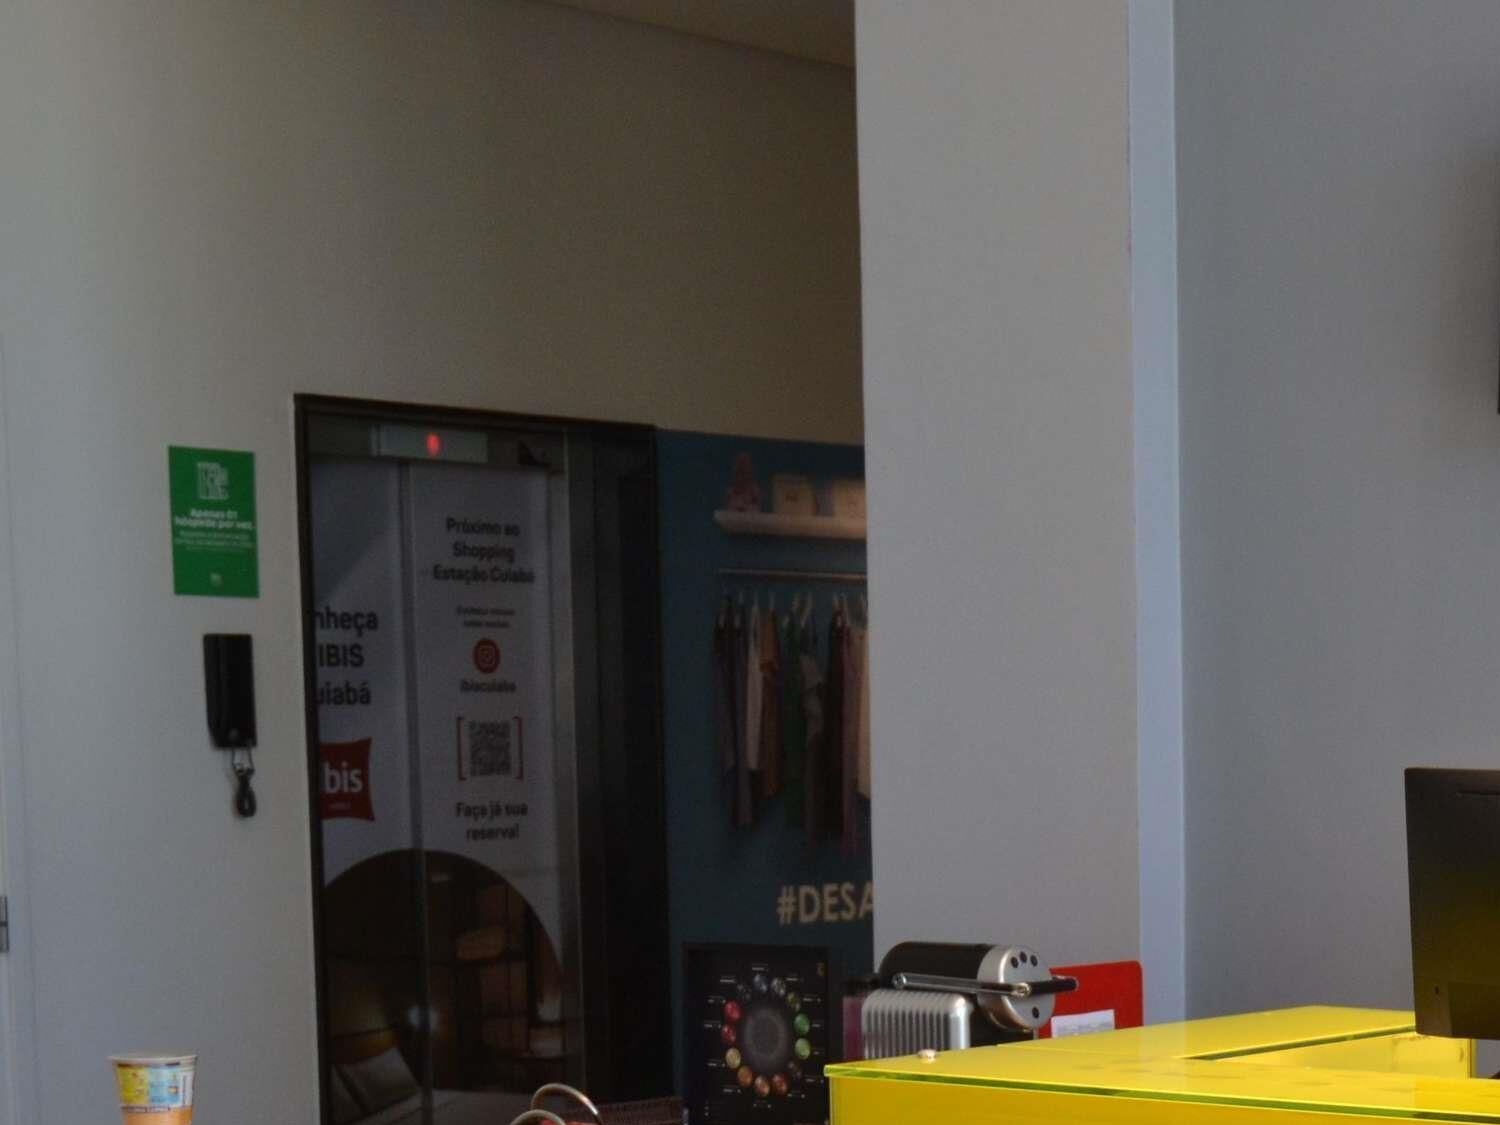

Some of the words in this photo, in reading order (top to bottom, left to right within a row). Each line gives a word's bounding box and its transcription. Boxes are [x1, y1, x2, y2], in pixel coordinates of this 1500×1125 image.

[446, 517, 502, 535] Próximo
[504, 523, 521, 537] ao
[452, 541, 516, 564] Shopping
[433, 564, 489, 586] Estação
[318, 642, 365, 668] IBIS
[456, 801, 488, 821] Faça
[489, 799, 503, 821] já
